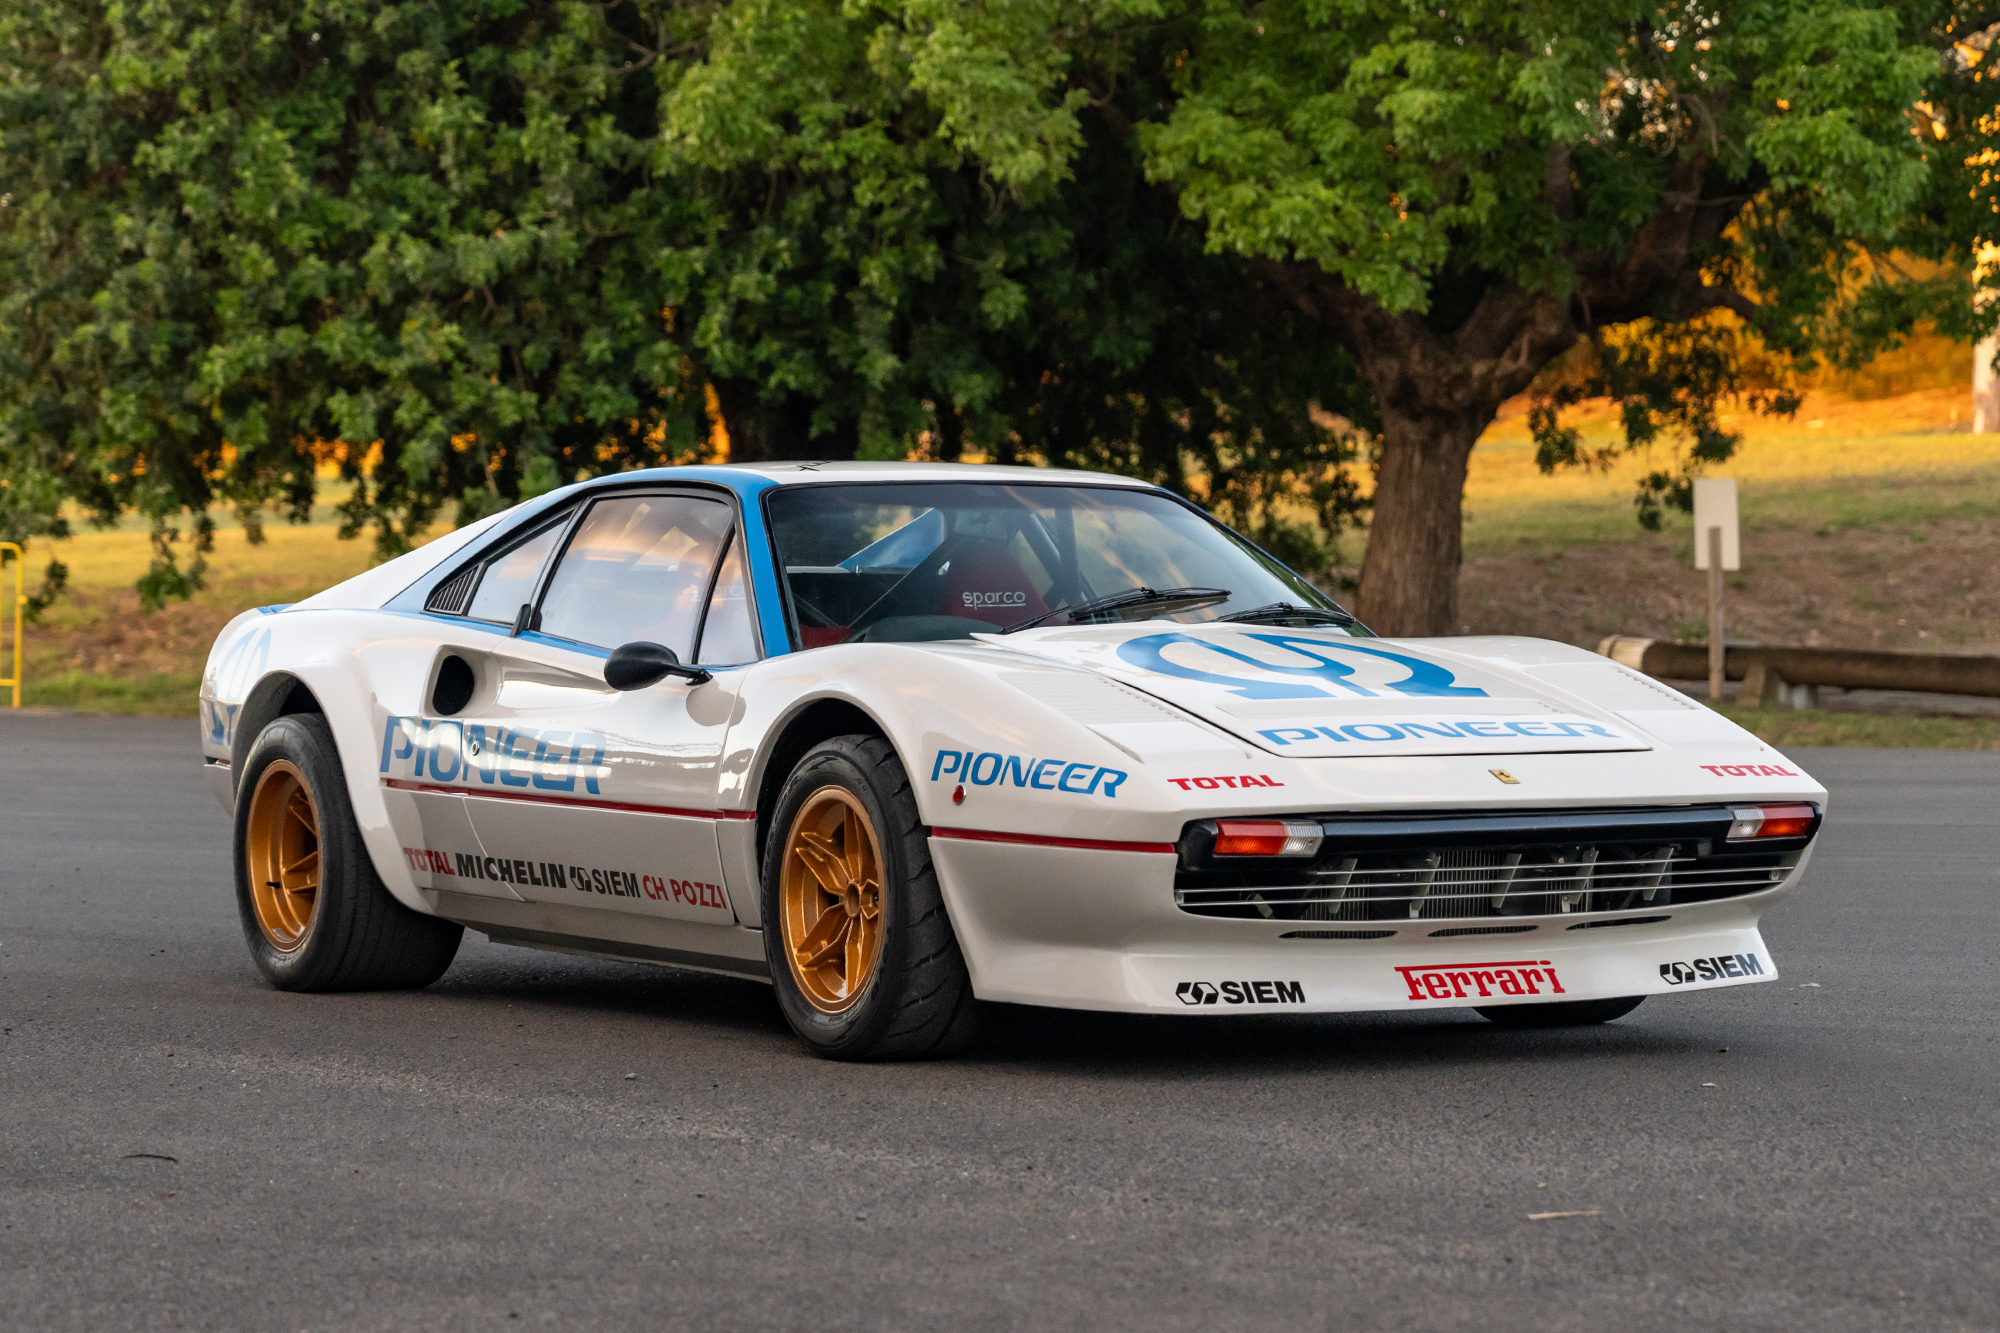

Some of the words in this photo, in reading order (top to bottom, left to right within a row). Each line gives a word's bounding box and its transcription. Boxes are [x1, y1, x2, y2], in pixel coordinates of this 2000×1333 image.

[962, 591, 1026, 610] sparco
[1255, 721, 1622, 745] PIONEER
[379, 714, 606, 796] PIONEER
[931, 750, 1128, 798] PIONEER
[1167, 775, 1284, 790] TOTAL
[1699, 764, 1798, 777] TOTAL
[403, 847, 454, 875] TOTAL
[456, 853, 567, 889] MICHELIN
[594, 871, 640, 898] SIEM
[643, 875, 668, 901] CH
[673, 878, 727, 910] POZZI
[1693, 953, 1764, 980] SIEM
[1221, 980, 1306, 1005] SIEM
[1394, 960, 1566, 1001] Ferrari
